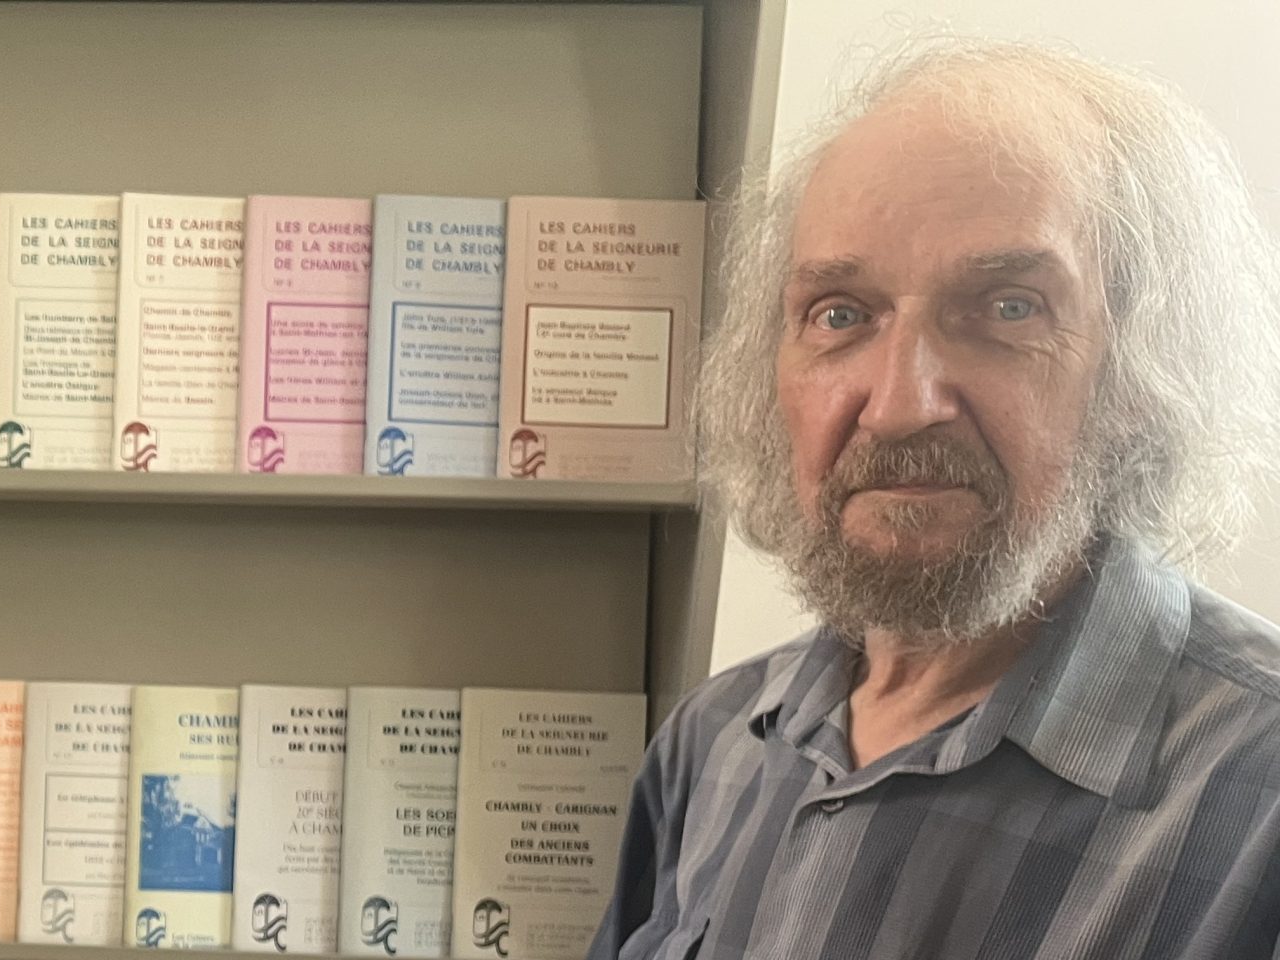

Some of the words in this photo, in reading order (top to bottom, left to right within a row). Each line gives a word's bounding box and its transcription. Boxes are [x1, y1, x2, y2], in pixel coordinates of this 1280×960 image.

[22, 217, 47, 230] LES
[55, 218, 117, 231] CAHIERS
[148, 218, 173, 230] LES
[180, 218, 242, 232] CAHIERS
[275, 221, 301, 234] LES
[308, 222, 371, 236] CAHIERS
[407, 221, 433, 234] LES
[440, 223, 505, 237] CAHIERS
[539, 222, 566, 235] LES
[572, 223, 637, 236] CAHIERS
[21, 236, 40, 248] DE
[49, 236, 67, 248] LA
[146, 236, 165, 248] DE
[174, 236, 192, 249] LA
[274, 239, 293, 252] DE
[301, 240, 320, 252] LA
[406, 240, 424, 252] DE
[433, 241, 452, 252] LA
[538, 240, 558, 253] DE
[566, 241, 585, 253] LA
[593, 242, 682, 257] SEIGNEURIE
[21, 254, 40, 266] DE
[47, 254, 118, 267] CHAMBLY
[146, 254, 165, 266] DE
[173, 255, 244, 269] CHAMBLY
[274, 258, 292, 270] DE
[301, 259, 371, 273] CHAMBLY
[405, 257, 424, 270] DE
[432, 260, 502, 274] CHAMBLY
[537, 259, 557, 272] DE
[564, 260, 636, 274] CHAMBLY
[73, 704, 96, 714] LES
[290, 707, 314, 719] LES
[402, 708, 425, 720] LES
[519, 711, 540, 723] LES
[542, 712, 593, 724] CAHIERS
[55, 722, 71, 733] DE
[76, 722, 92, 733] LA
[272, 724, 288, 734] DE
[293, 725, 308, 735] LA
[383, 726, 399, 736] DE
[405, 726, 420, 737] LA
[502, 728, 517, 739] DE
[521, 728, 535, 740] LA
[538, 730, 609, 741] SEIGNEURIE
[72, 742, 89, 752] DE
[288, 742, 305, 752] DE
[400, 744, 417, 754] DE
[517, 743, 532, 755] DE
[535, 744, 591, 757] CHAMBLY
[396, 807, 421, 820] LES
[485, 801, 543, 815] CHAMBLY
[555, 803, 618, 816] CARIGNAN
[403, 824, 421, 836] DE
[521, 821, 537, 832] UN
[541, 822, 580, 833] CHOIX
[510, 838, 534, 850] DES
[538, 840, 590, 851] ANCIENS
[504, 852, 594, 867] COMBATTANTS
